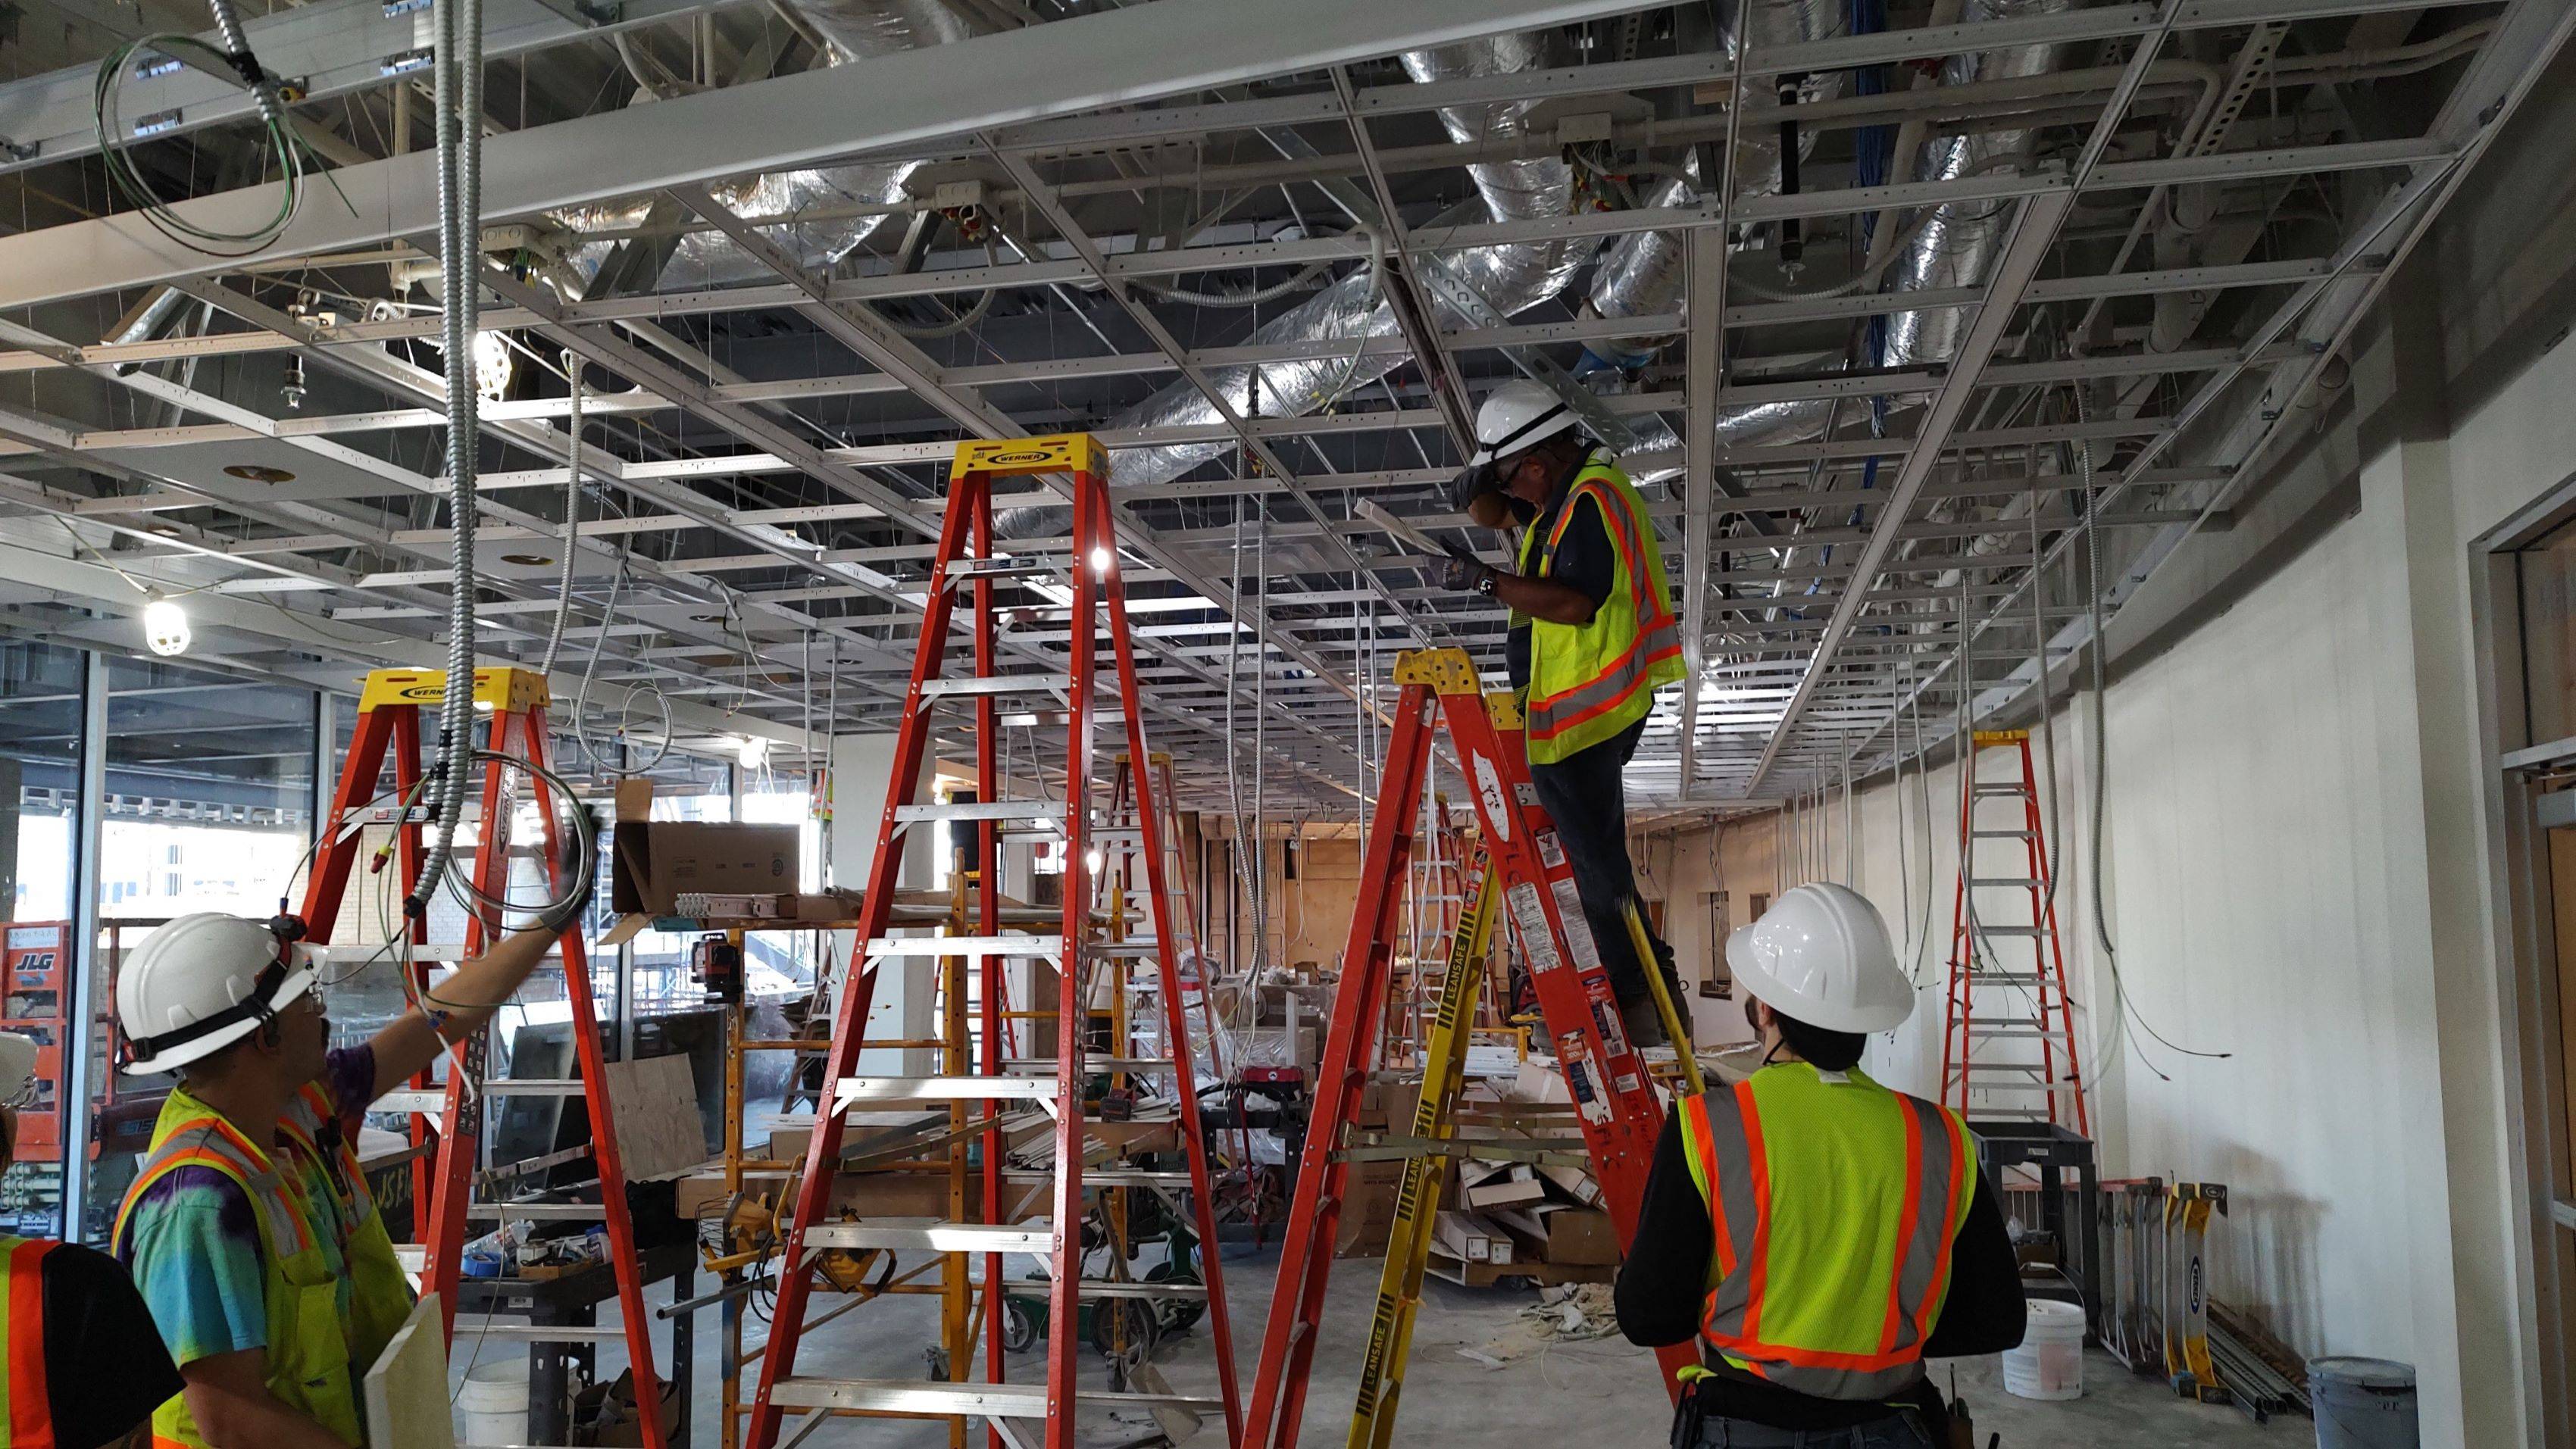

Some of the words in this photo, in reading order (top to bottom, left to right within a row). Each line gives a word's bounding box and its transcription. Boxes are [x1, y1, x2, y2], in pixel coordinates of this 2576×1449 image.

[15, 953, 56, 972] JLG
[1446, 943, 1467, 999] LEANSAFE
[1365, 1326, 1386, 1385] LEANSAFE
